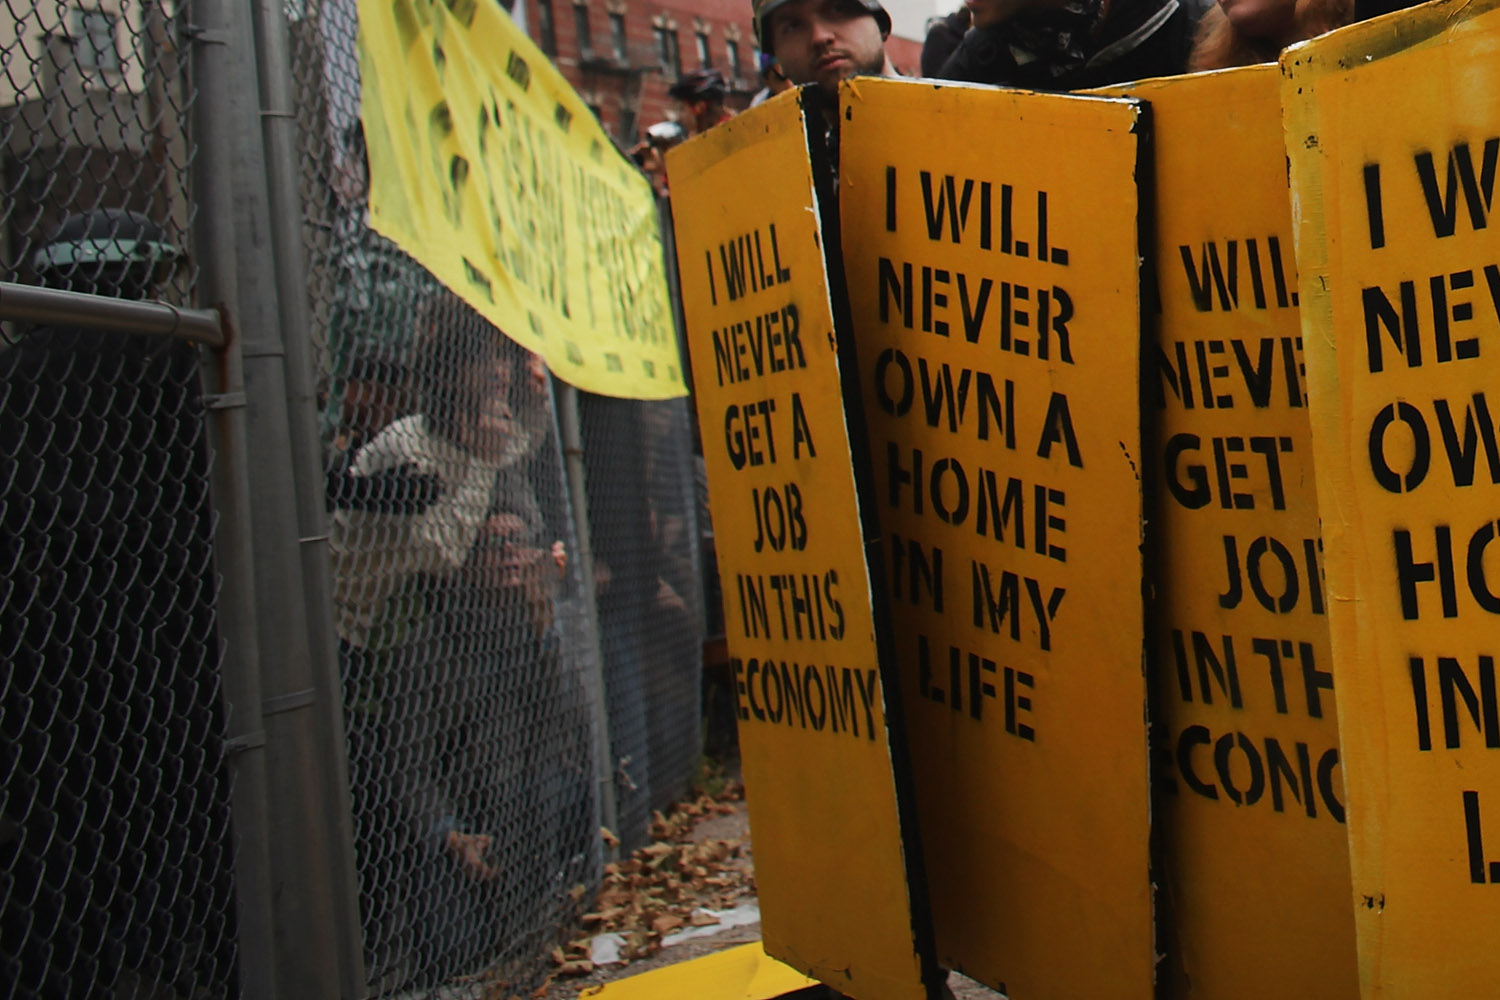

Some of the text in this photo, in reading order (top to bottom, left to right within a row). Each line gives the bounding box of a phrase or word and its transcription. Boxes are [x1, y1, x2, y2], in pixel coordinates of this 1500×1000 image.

[885, 165, 1069, 267] I WILL
[1363, 163, 1385, 250] I
[705, 222, 792, 306] I WILL
[712, 303, 808, 388] NEVER
[878, 256, 1074, 365] NEVER
[724, 392, 816, 471] GET A
[874, 348, 1083, 468] OWN A
[887, 441, 1067, 563] HOME
[1164, 433, 1292, 512] GET
[752, 481, 808, 554] JOB
[737, 568, 845, 641] IN THIS
[891, 532, 1066, 652] IN MY
[731, 657, 876, 742] ECONOMY
[918, 634, 1036, 742] LIFE
[1172, 629, 1243, 711] IN
